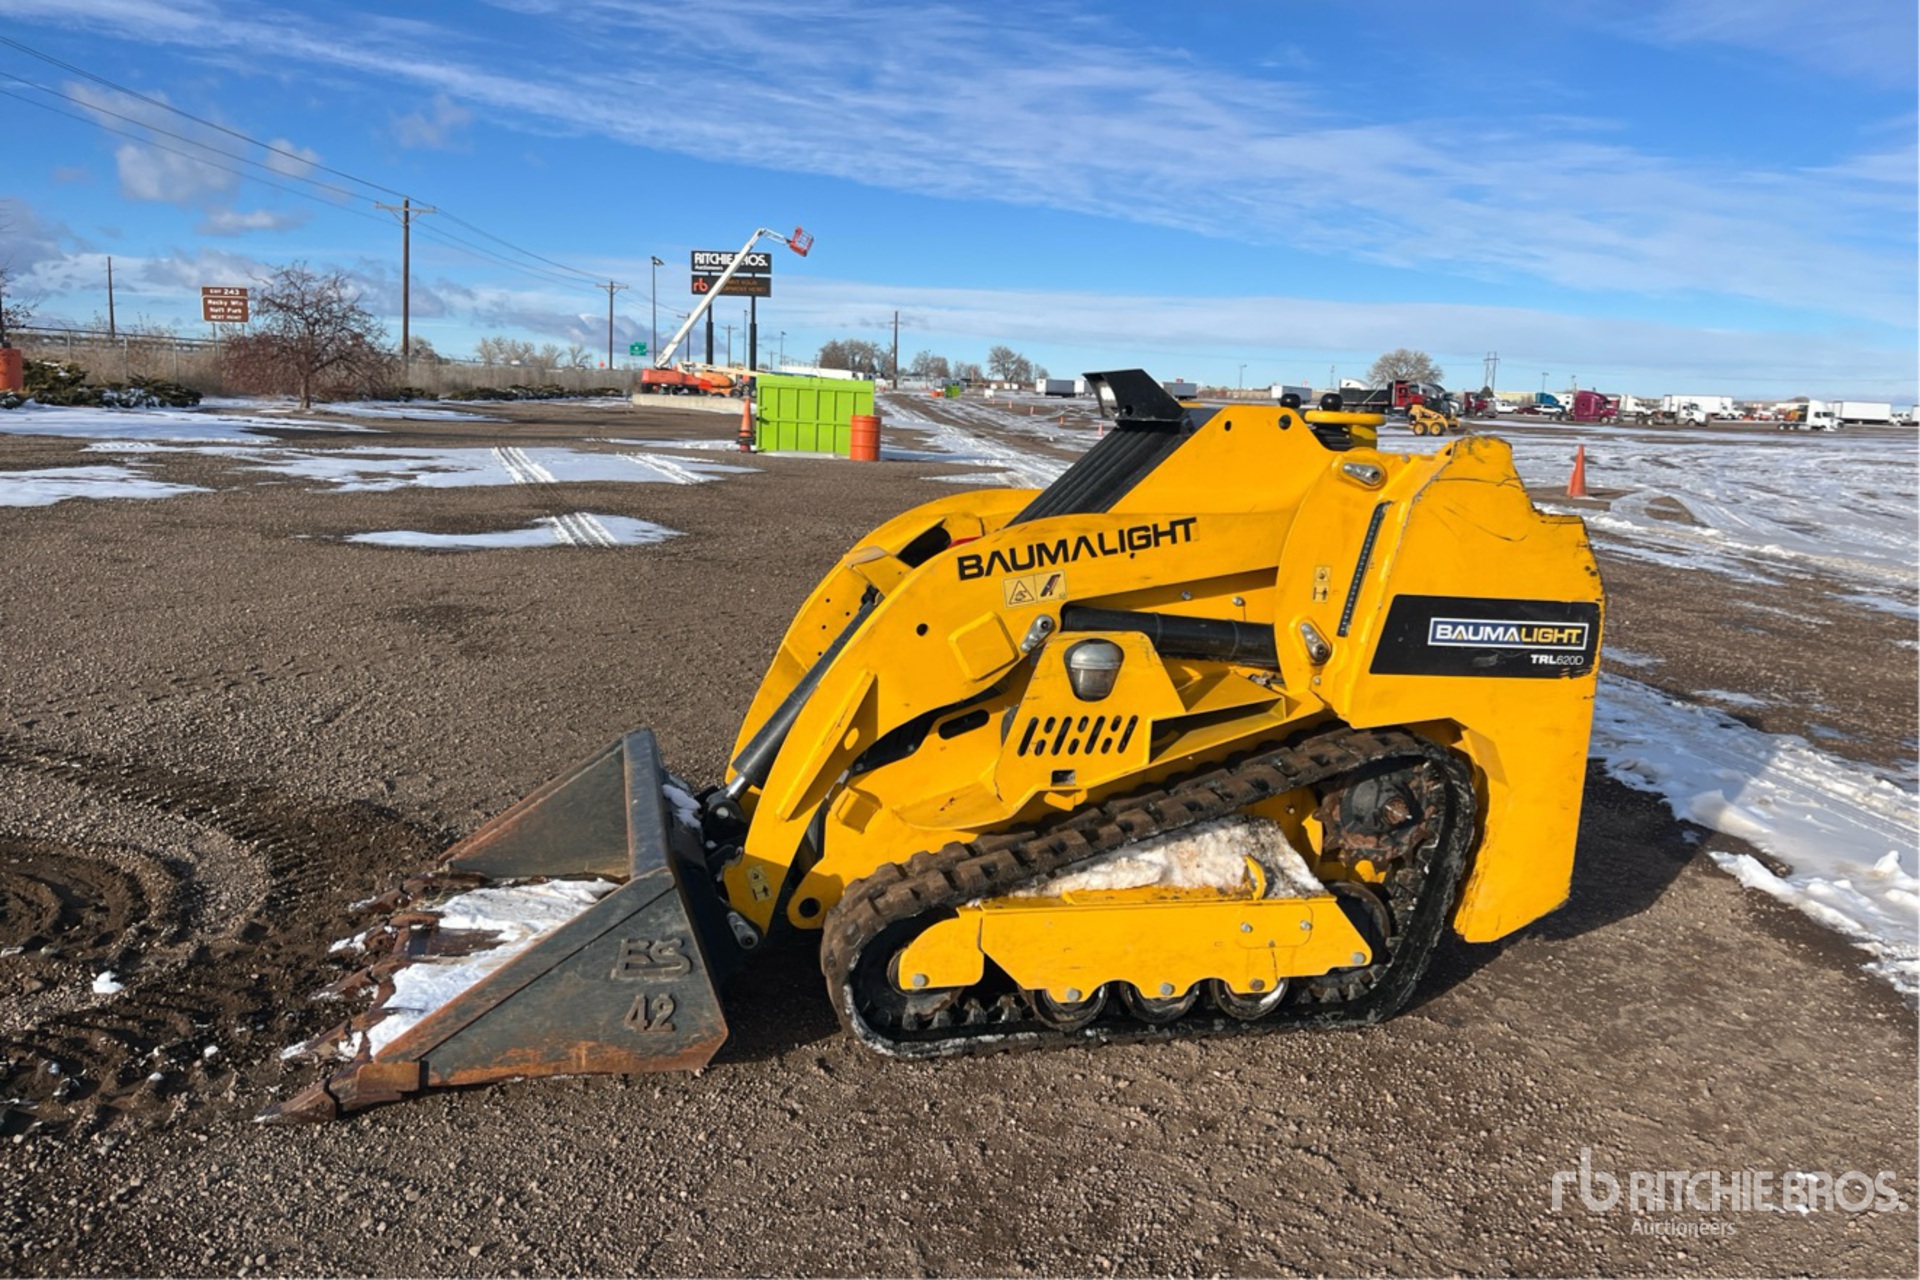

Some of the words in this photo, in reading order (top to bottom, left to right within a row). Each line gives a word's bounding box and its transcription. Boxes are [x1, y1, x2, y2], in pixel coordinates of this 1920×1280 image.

[694, 252, 733, 265] RITCHIE
[693, 277, 709, 292] rb
[957, 517, 1197, 581] BAUMALIGHT
[1435, 624, 1583, 644] BAUMALIGHT
[1530, 654, 1584, 666] TRL620D
[624, 992, 676, 1033] 42
